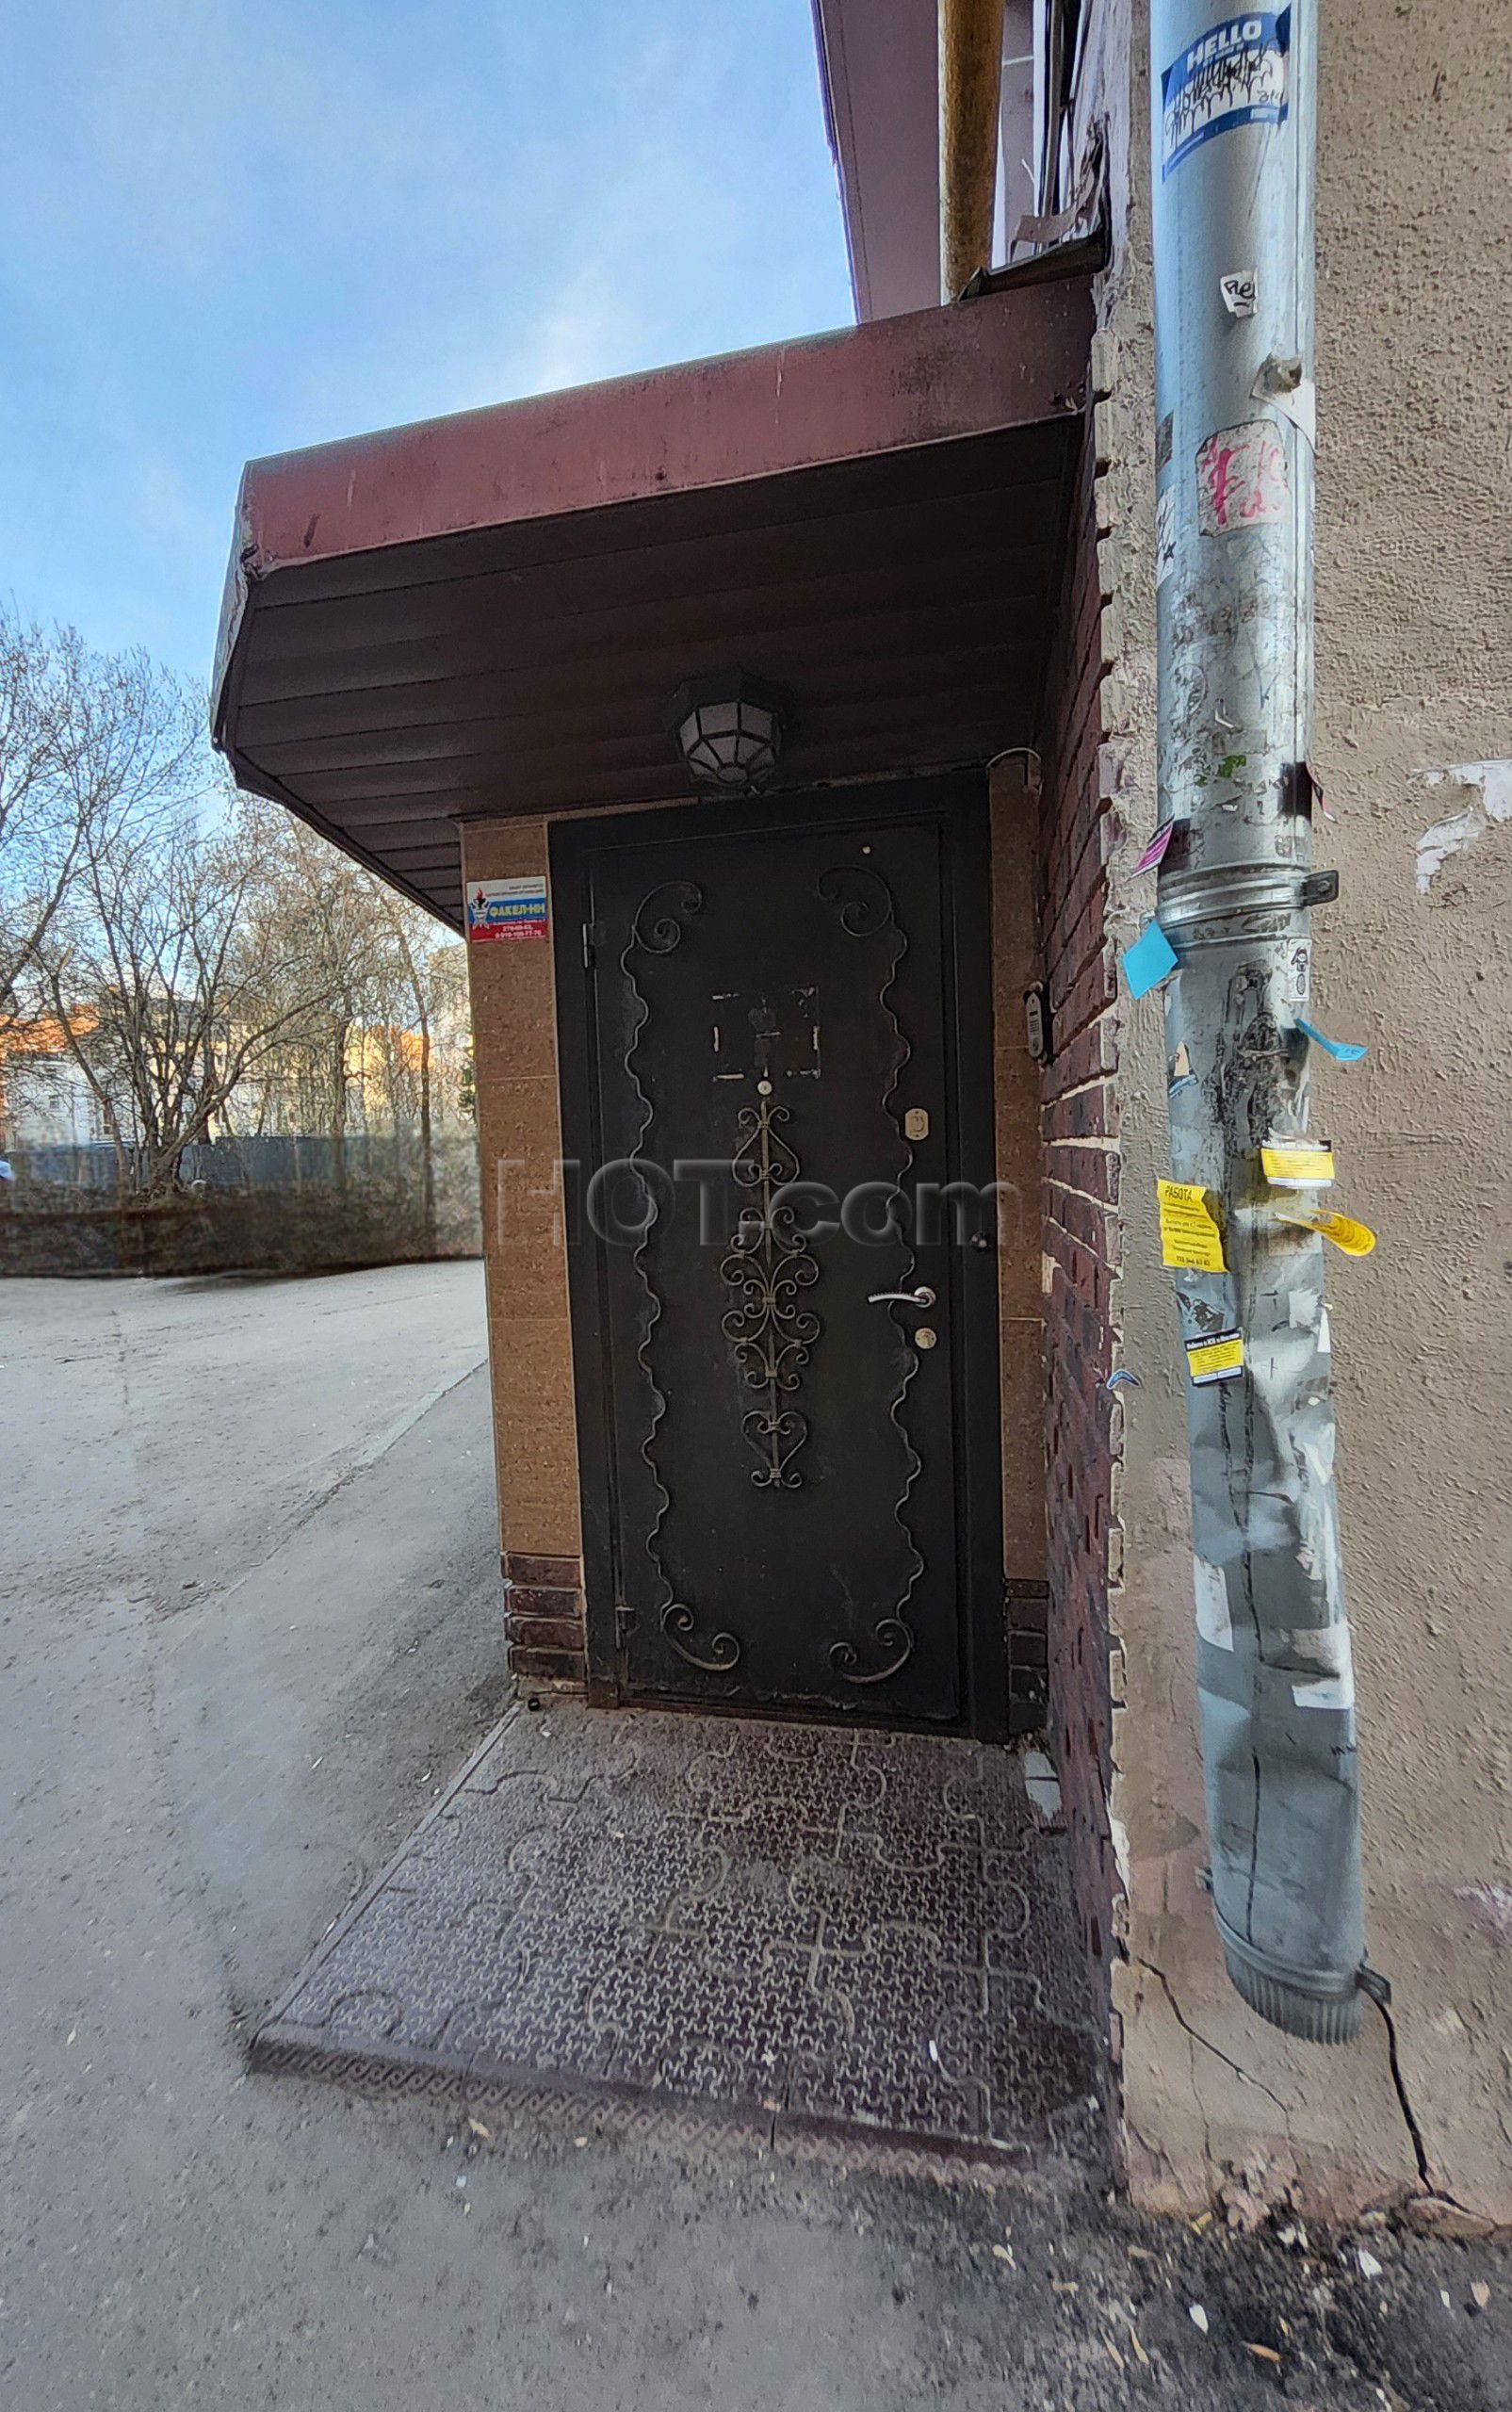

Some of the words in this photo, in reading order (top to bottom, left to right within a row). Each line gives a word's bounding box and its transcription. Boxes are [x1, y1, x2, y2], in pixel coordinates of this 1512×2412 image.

[1187, 20, 1262, 74] HELLO
[489, 904, 545, 918] ФАКЕЛ-НН
[1164, 1185, 1193, 1201] РАБОТА
